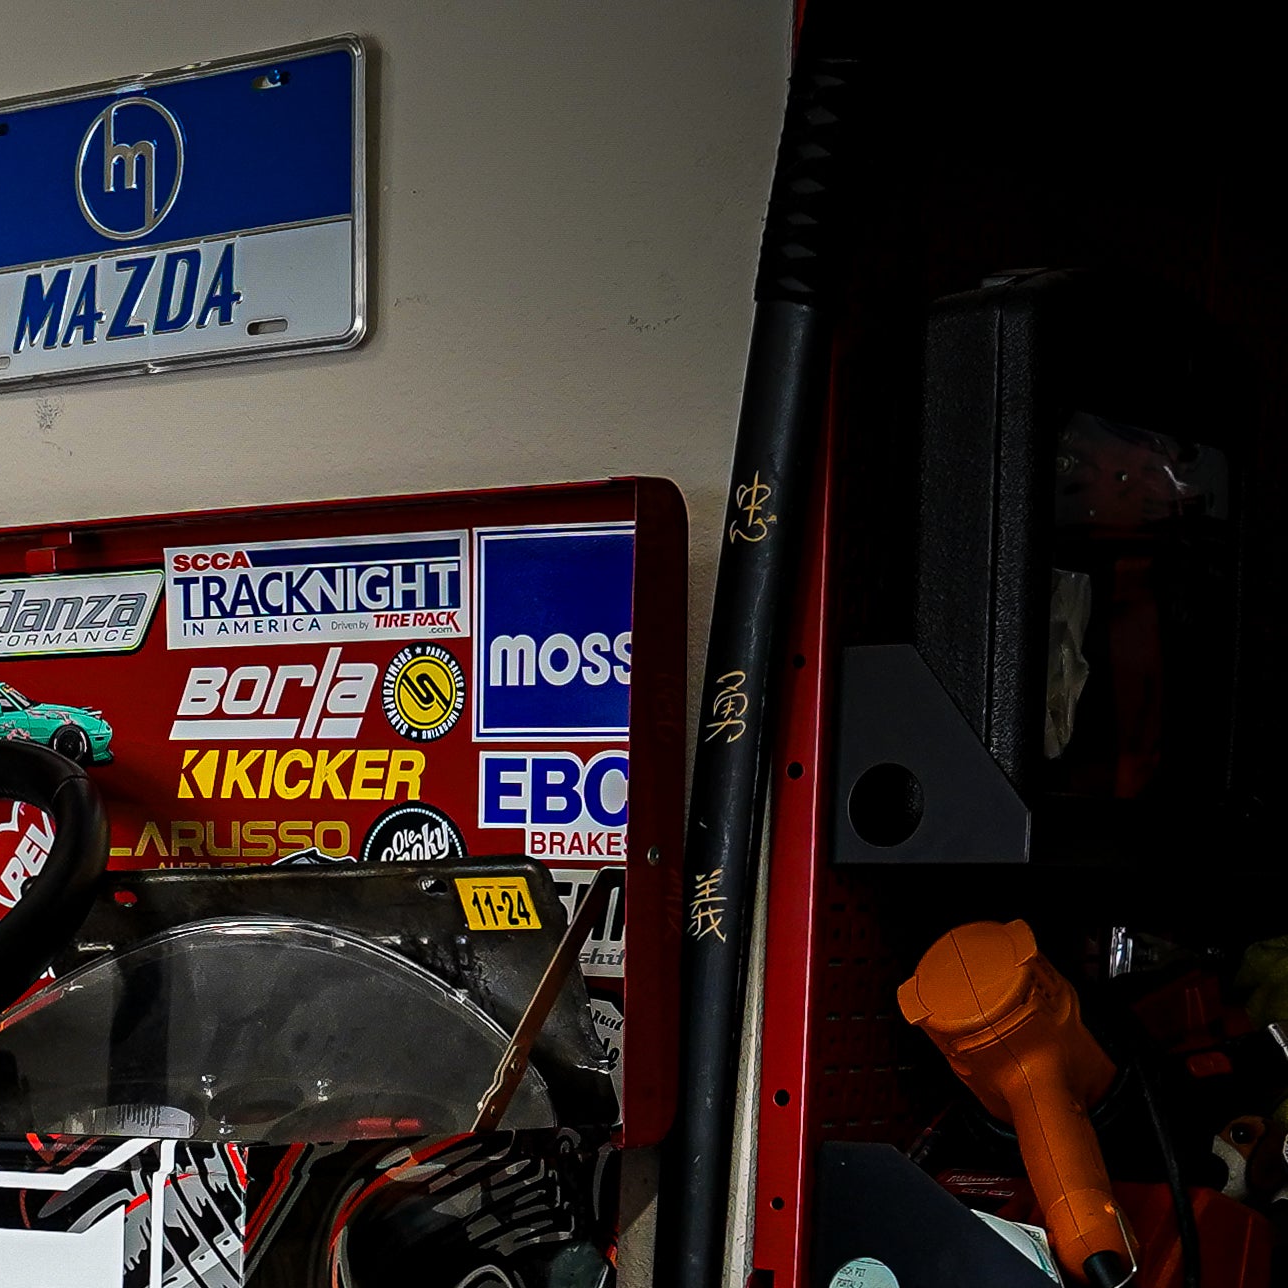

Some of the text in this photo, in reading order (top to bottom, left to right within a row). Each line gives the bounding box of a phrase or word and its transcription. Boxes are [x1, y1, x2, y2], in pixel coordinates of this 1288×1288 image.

[12, 242, 243, 354] MAZDA
[173, 551, 252, 572] SCCA
[182, 610, 461, 636] IN AMERICA Driven by TIRE RACK
[220, 748, 426, 800] KICKER
[484, 754, 629, 826] EBC
[530, 832, 627, 856] BRAKE
[472, 890, 531, 927] 11-24
